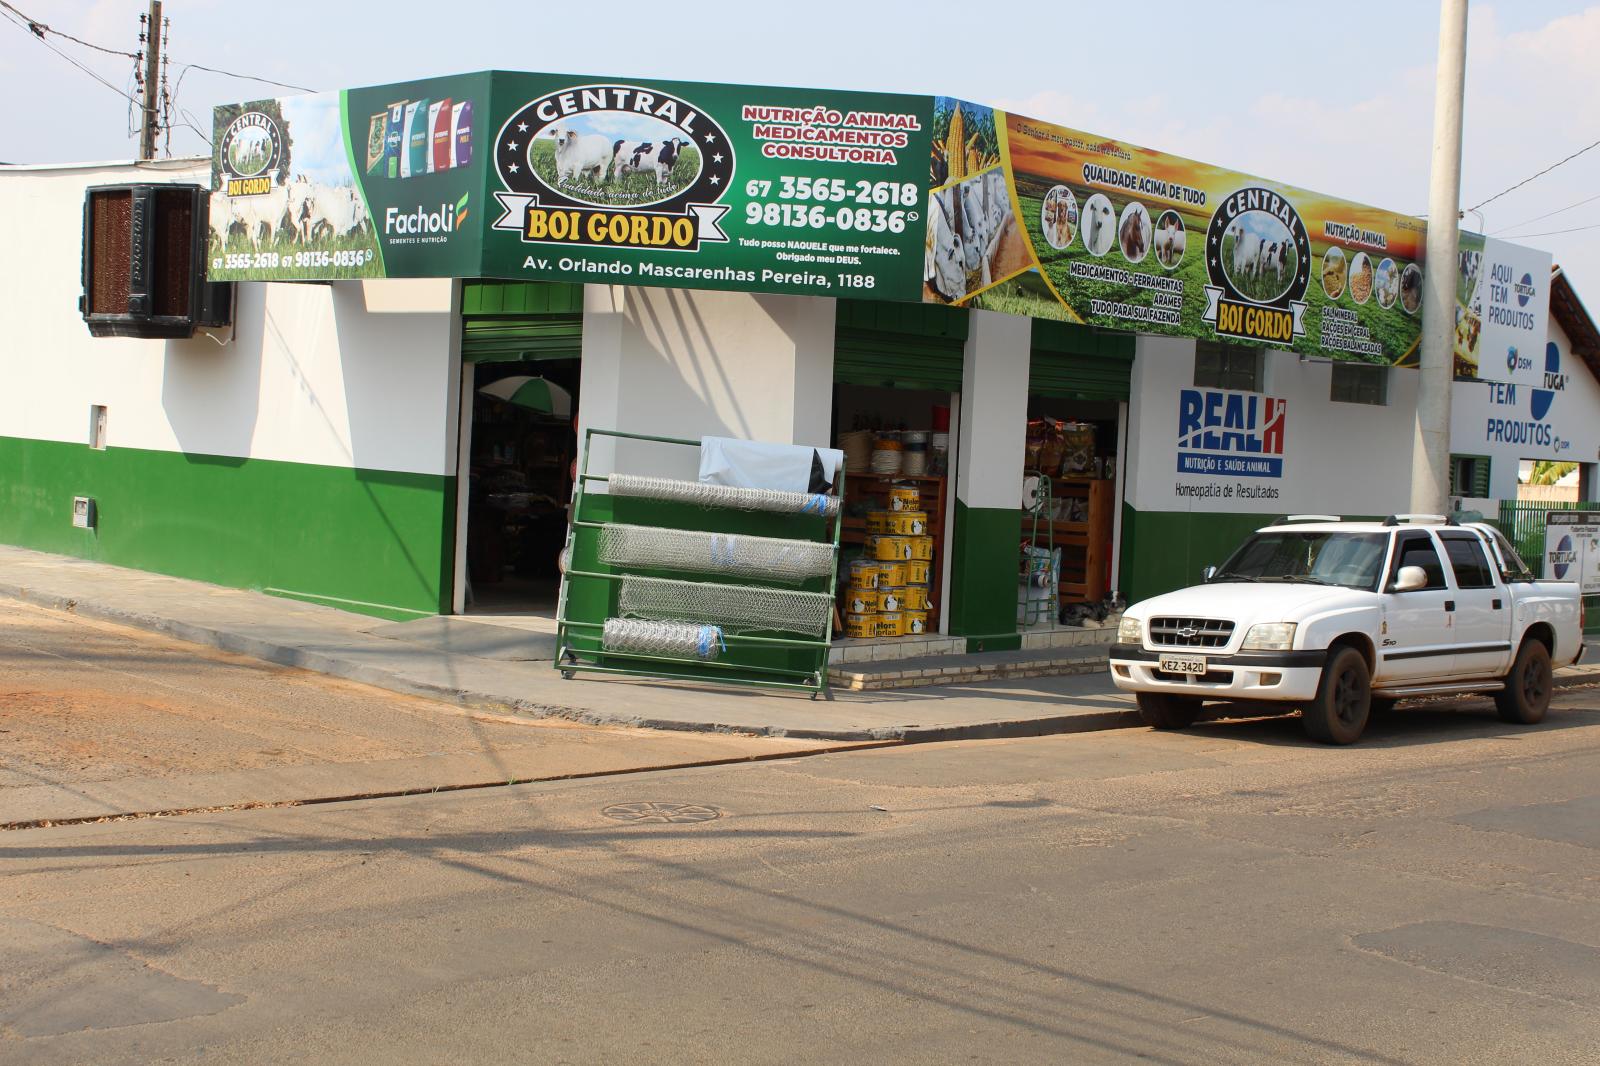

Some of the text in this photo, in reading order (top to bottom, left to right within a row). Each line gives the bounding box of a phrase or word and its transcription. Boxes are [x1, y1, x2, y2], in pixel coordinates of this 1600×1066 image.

[536, 88, 698, 135] CENTRAL
[743, 104, 920, 130] NUTRIÇÃO ANIMAL
[230, 114, 272, 135] CENTRAL
[754, 126, 907, 147] MEDICAMENTOS
[763, 144, 897, 165] CONSULTORIA
[228, 177, 270, 196] BOI GORDO
[746, 176, 918, 206] 67 3565-2618
[1082, 164, 1206, 207] QUALIDADE ACIMA DE TUDO
[385, 203, 454, 235] Facholi
[746, 202, 906, 233] 98136-0836
[1226, 189, 1299, 236] CENTRAL
[528, 209, 694, 247] BOI GORDO
[1325, 221, 1387, 249] NUTRIÇÃO ANIMAL
[421, 235, 448, 244] NUTRIÇÃO
[739, 238, 901, 256] Tudo posso NAQUELE que me fortalece.
[213, 250, 364, 269] 67 3565-2618 67 98136-0836
[776, 252, 862, 265] Obrigado meu DEUS.
[522, 255, 876, 288] Av. Orlando Mascarenhas Pereira, 1188
[1070, 262, 1129, 284] MEDICAMENTOS
[1134, 273, 1184, 293] FERRAMENTAS
[1490, 263, 1513, 284] AQUI
[1490, 284, 1508, 305] TEM
[1514, 283, 1536, 297] TORTUGA
[1153, 293, 1182, 309] ARAMES
[1091, 300, 1181, 325] TUDO PARA SUA FAZENDA
[1218, 303, 1293, 341] BOI GORDO
[1334, 308, 1358, 323] MINERAL
[1488, 305, 1534, 331] PRODUTOS
[1518, 357, 1533, 370] DSM
[1543, 373, 1565, 391] TUGA
[1488, 382, 1516, 405] TEM
[1486, 418, 1552, 447] PRODUTOS
[1184, 456, 1271, 473] NUTRIÇÃO E SAÚDE ANIMAL
[1175, 482, 1279, 500] Homeopatia de Resultados
[1549, 551, 1577, 564] TORTUGA
[1382, 638, 1397, 647] S10
